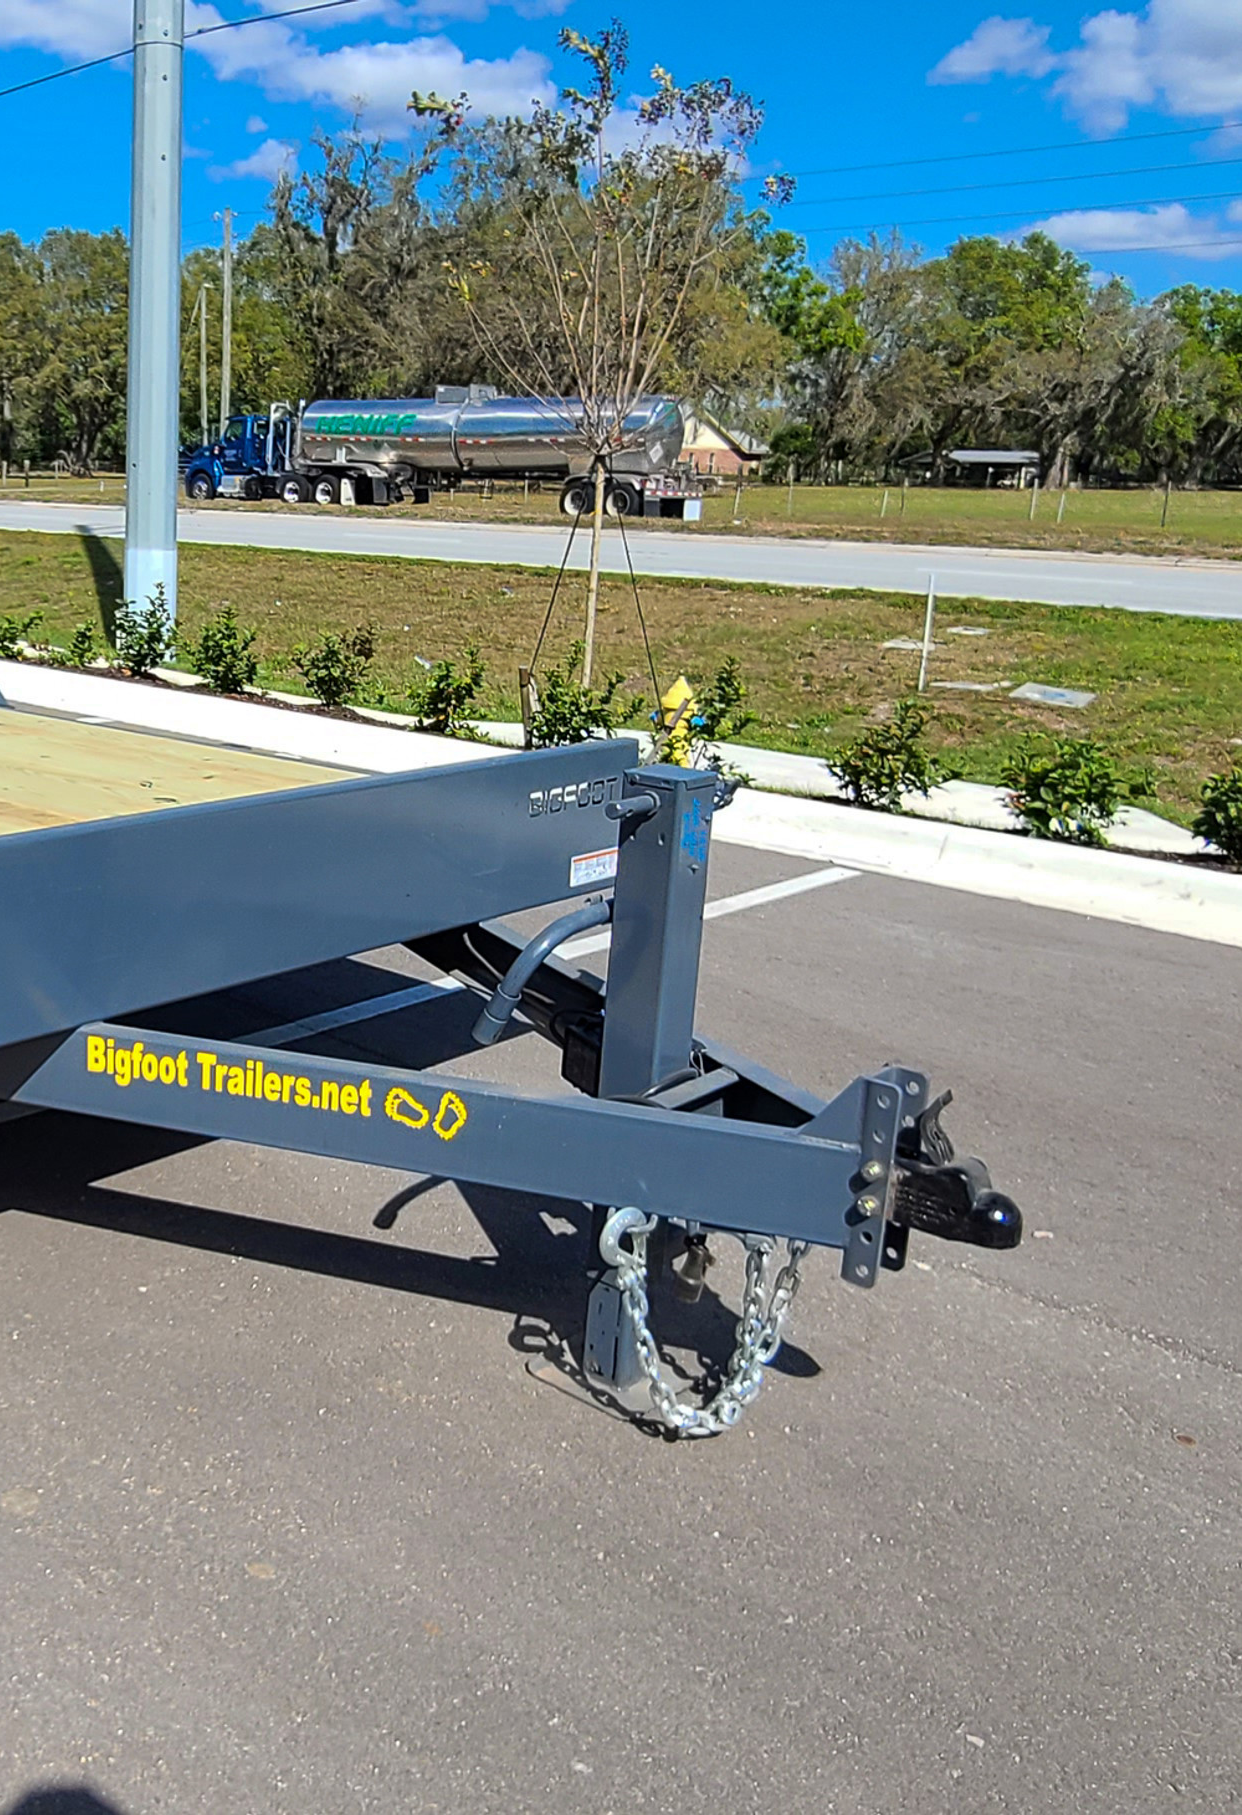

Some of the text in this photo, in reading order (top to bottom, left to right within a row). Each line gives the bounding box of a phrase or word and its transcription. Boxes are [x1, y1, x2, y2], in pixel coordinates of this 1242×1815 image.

[315, 413, 417, 435] HENIFF
[529, 777, 618, 818] BIGFOOT
[86, 1035, 372, 1117] Bigfoot Trailers.net
